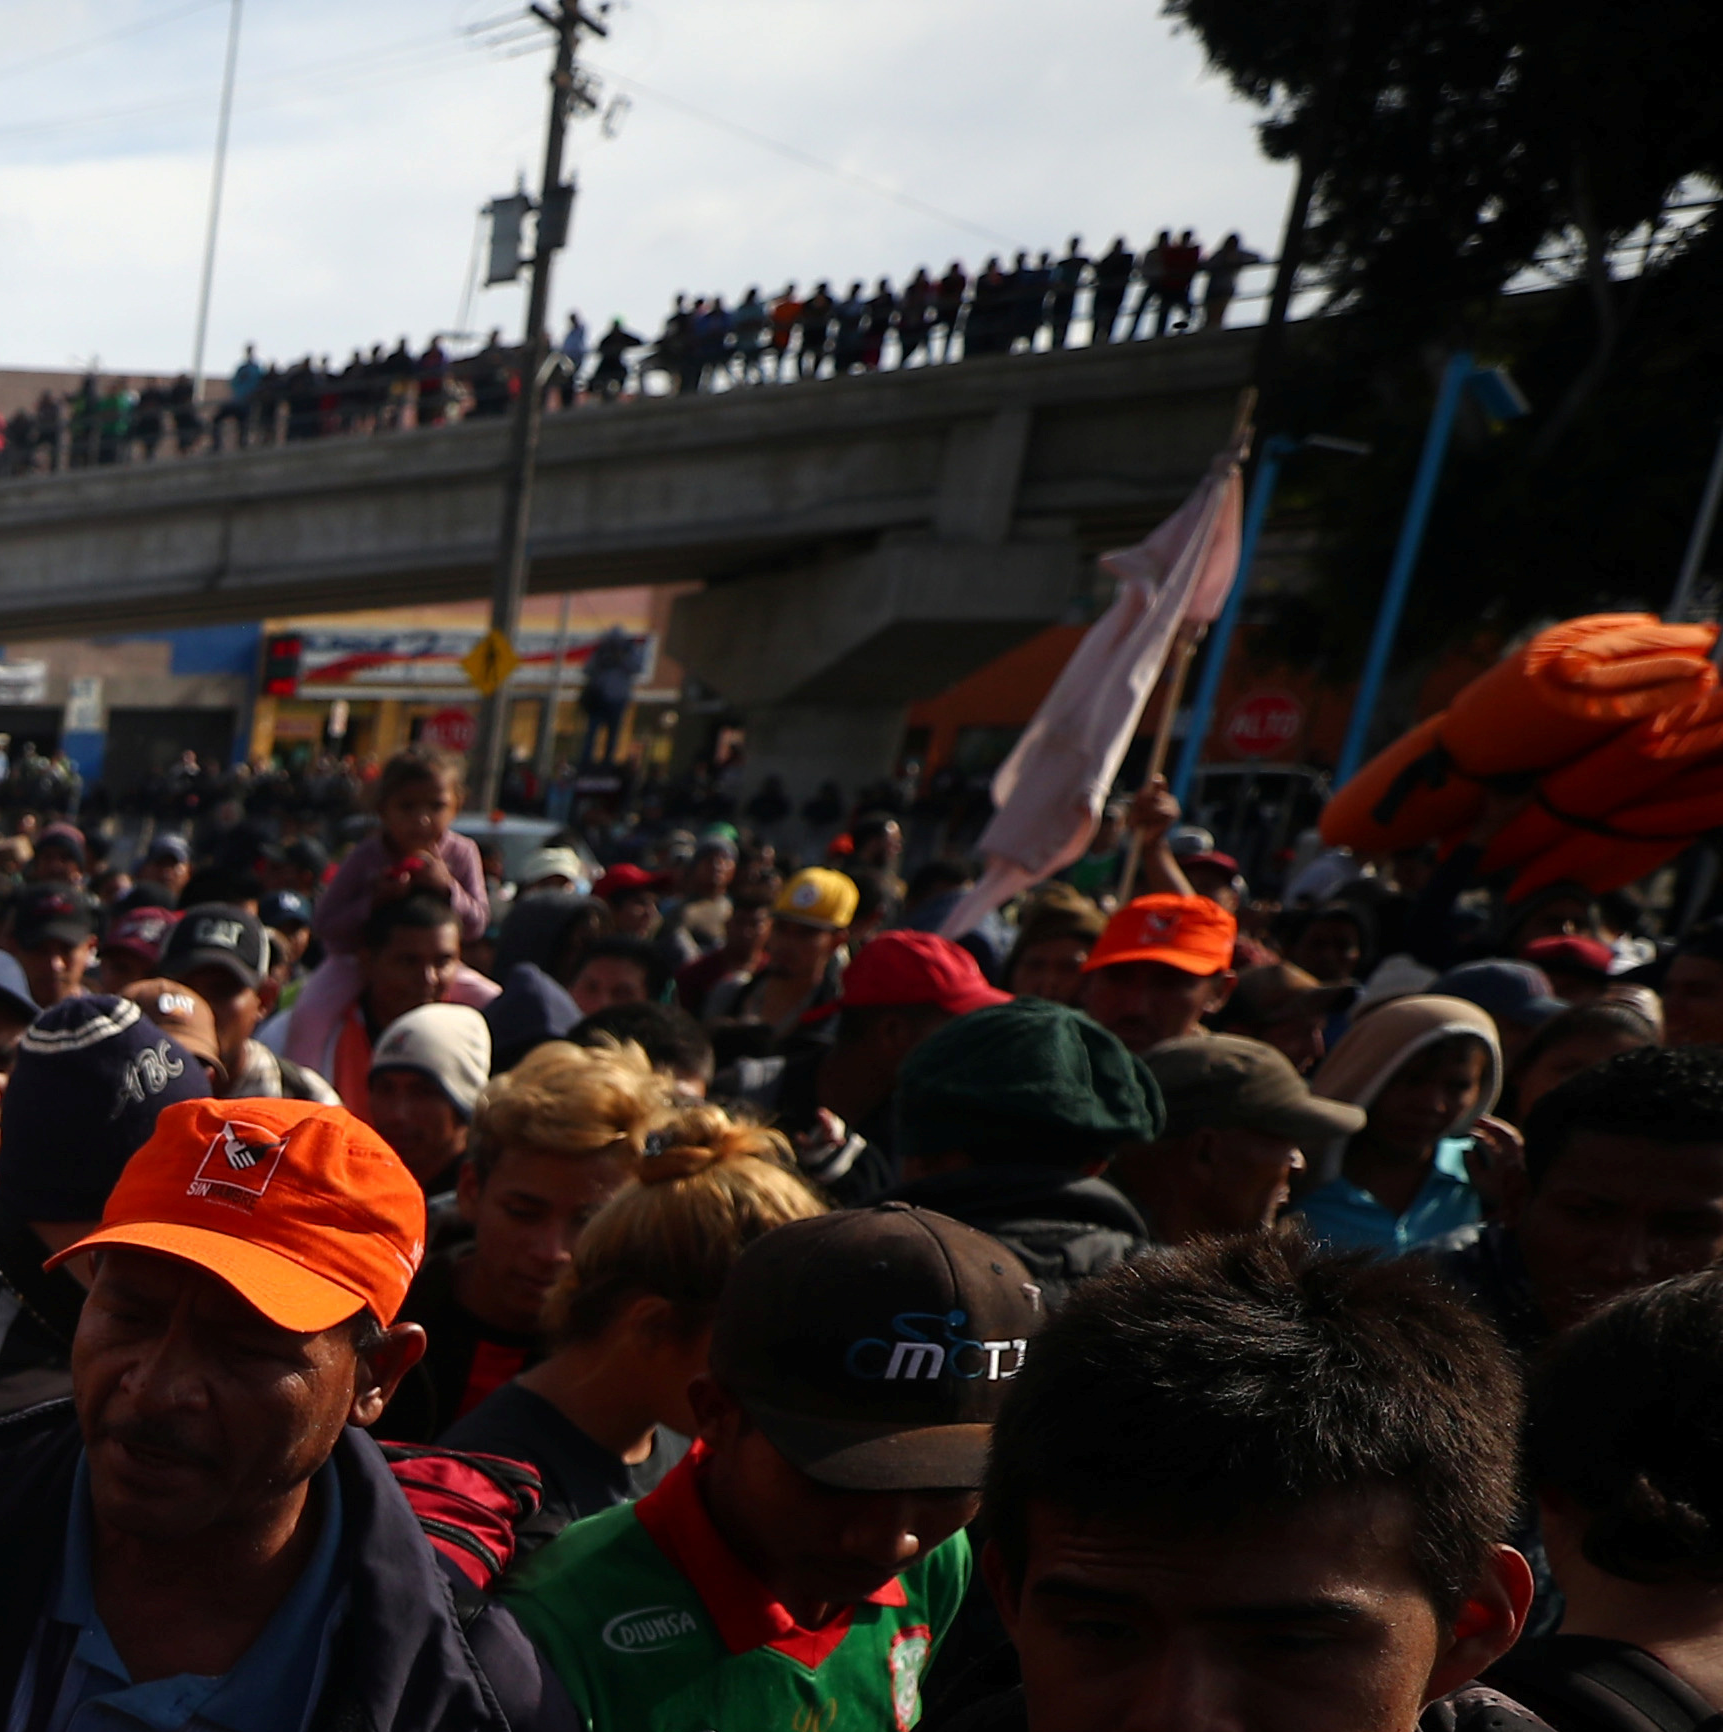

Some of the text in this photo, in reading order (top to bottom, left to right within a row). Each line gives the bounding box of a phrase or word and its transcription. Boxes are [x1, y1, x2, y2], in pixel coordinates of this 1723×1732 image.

[1228, 711, 1299, 740] ALTO
[111, 1038, 185, 1110] ABC
[185, 1181, 212, 1197] SIN
[618, 1610, 698, 1647] DIUNSA
